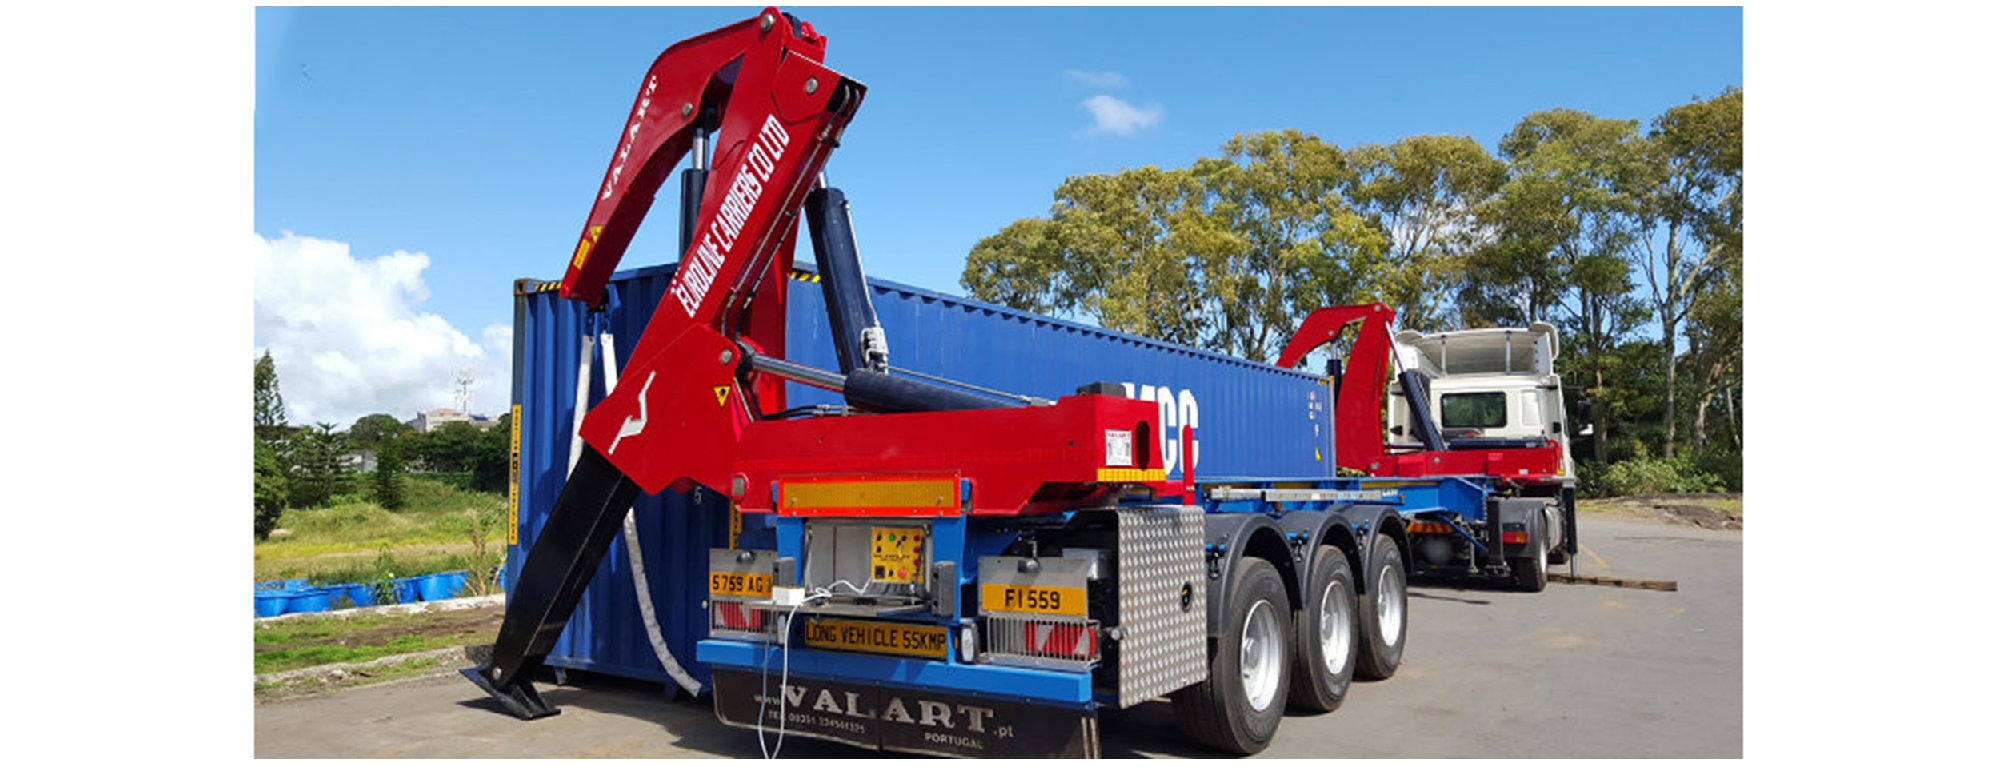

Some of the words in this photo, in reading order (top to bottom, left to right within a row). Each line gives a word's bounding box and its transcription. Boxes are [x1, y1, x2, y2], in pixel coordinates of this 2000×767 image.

[601, 75, 657, 201] VALART
[758, 113, 790, 161] LTD
[748, 142, 775, 184] CO
[711, 163, 763, 253] CARRIERS
[676, 233, 726, 318] EUROLINE
[712, 574, 743, 591] 5759
[747, 576, 763, 593] AG
[1027, 590, 1060, 610] 559
[806, 624, 837, 643] LONG
[840, 626, 898, 648] VEHICLE
[779, 684, 994, 734] VALART
[924, 732, 984, 750] PORTUGAL
